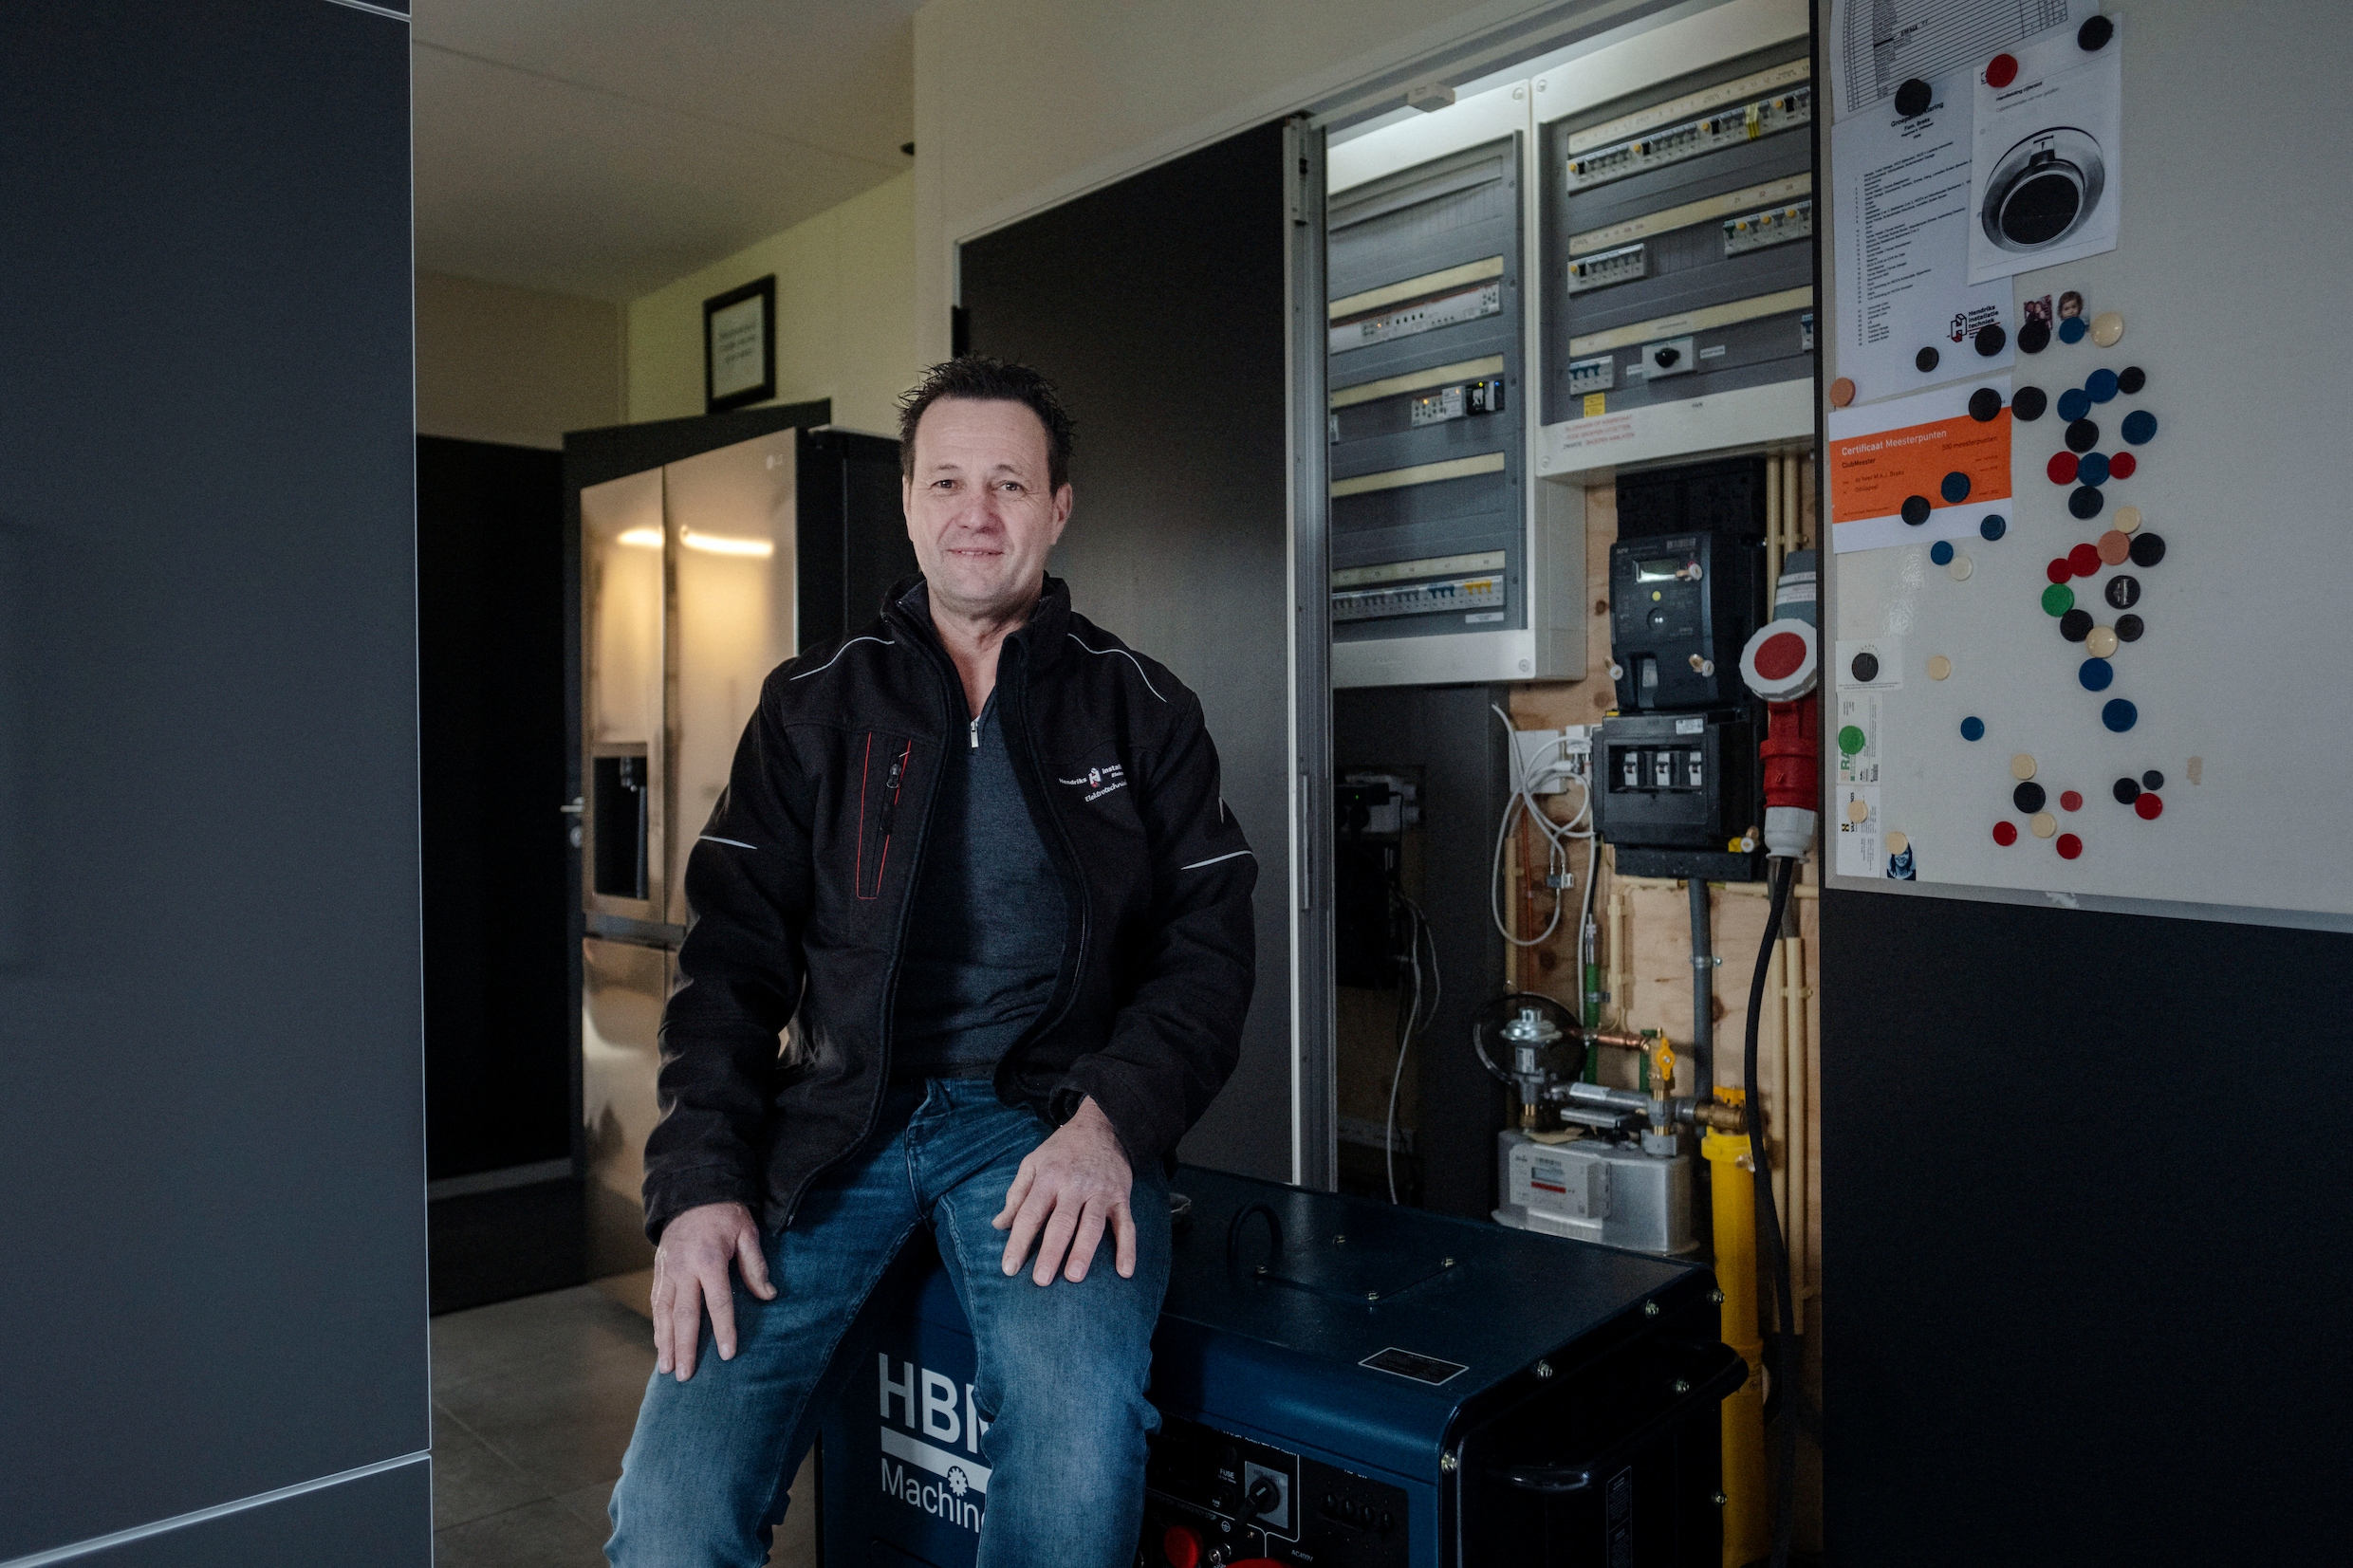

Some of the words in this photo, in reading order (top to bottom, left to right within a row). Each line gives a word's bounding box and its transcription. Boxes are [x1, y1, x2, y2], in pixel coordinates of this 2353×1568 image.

[1969, 305, 1995, 316] Hendriks
[1969, 311, 1999, 322] installatie
[1969, 318, 1994, 329] techniek
[1842, 441, 1883, 456] Certificaat
[1885, 430, 1947, 446] Meesterpunten
[1954, 436, 1997, 449] meesterpunten
[1842, 457, 1876, 469] ClubMeester
[1219, 1468, 1235, 1480] FUSE
[881, 1457, 985, 1534] Machin
